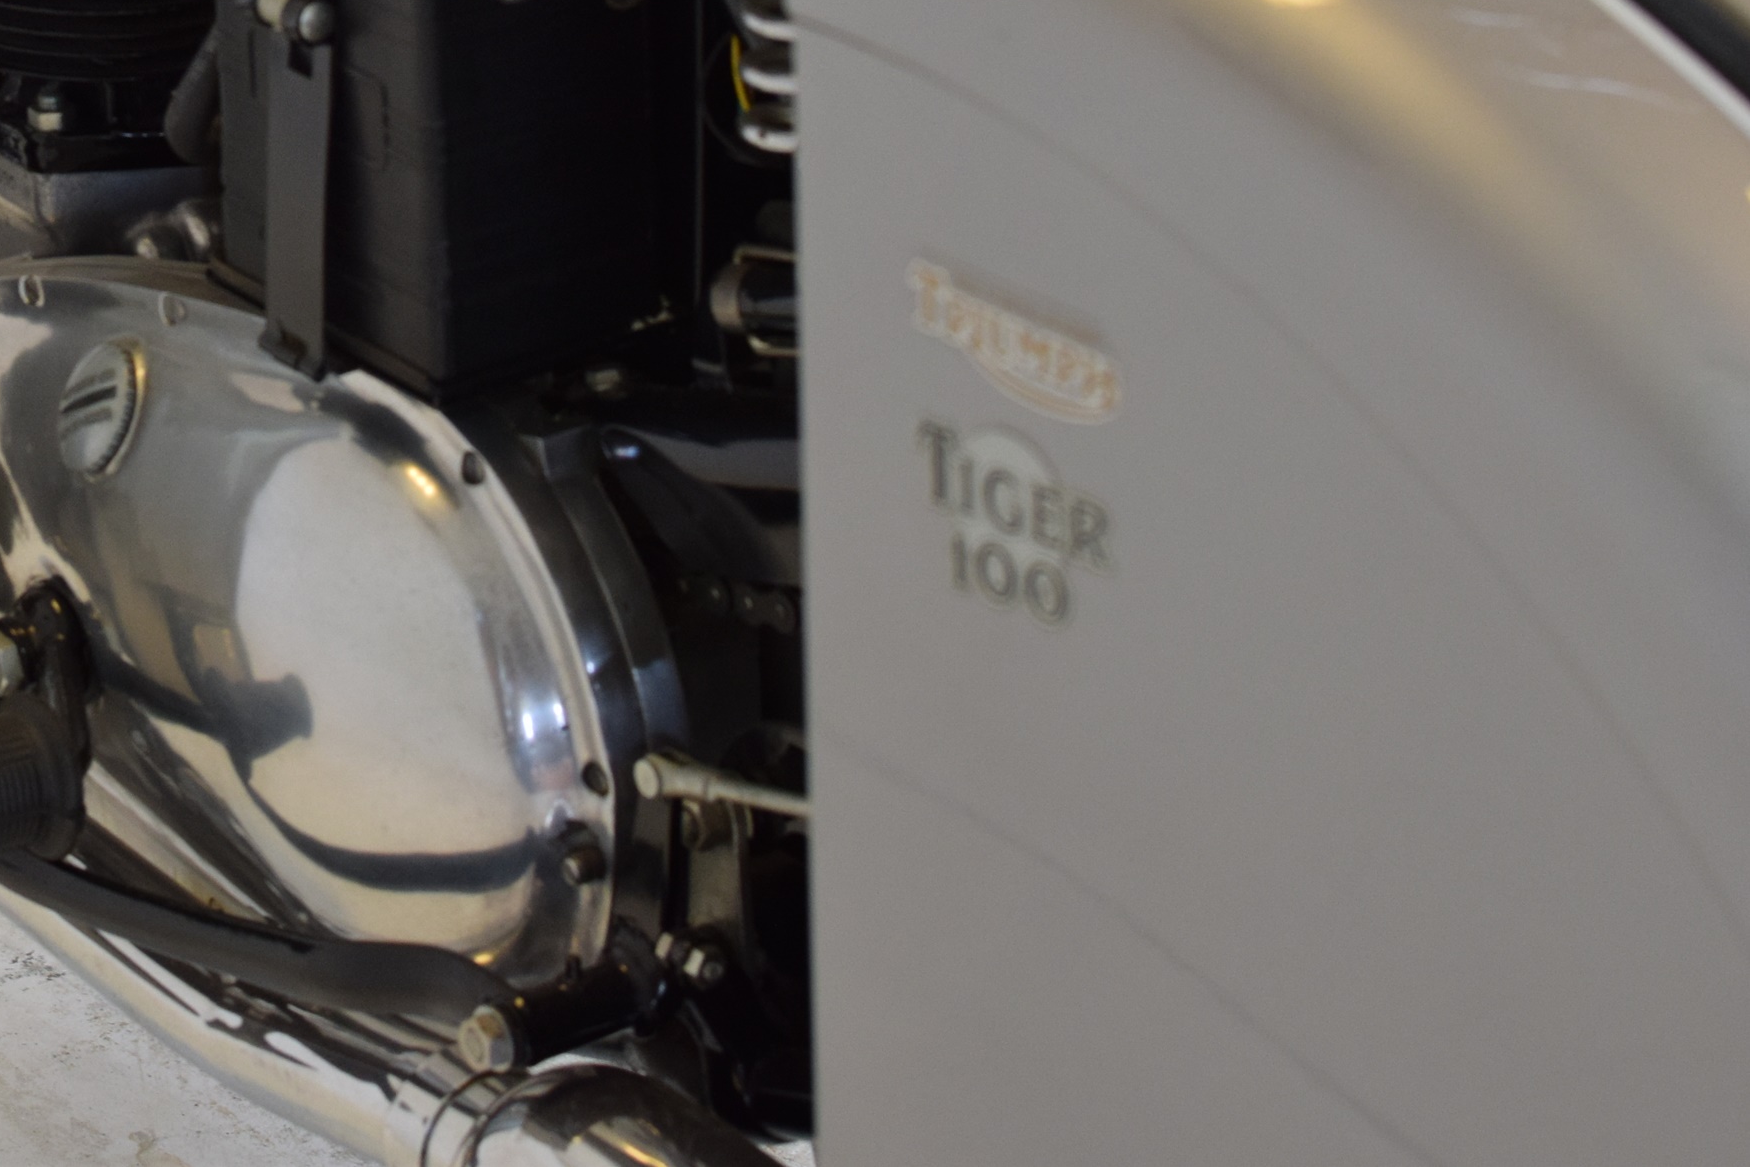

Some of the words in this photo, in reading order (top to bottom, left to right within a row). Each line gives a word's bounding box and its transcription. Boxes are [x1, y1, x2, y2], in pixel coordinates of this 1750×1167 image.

[910, 260, 1121, 412] TRIUMPH
[917, 419, 1113, 572] TIGER
[950, 532, 1072, 626] 100
